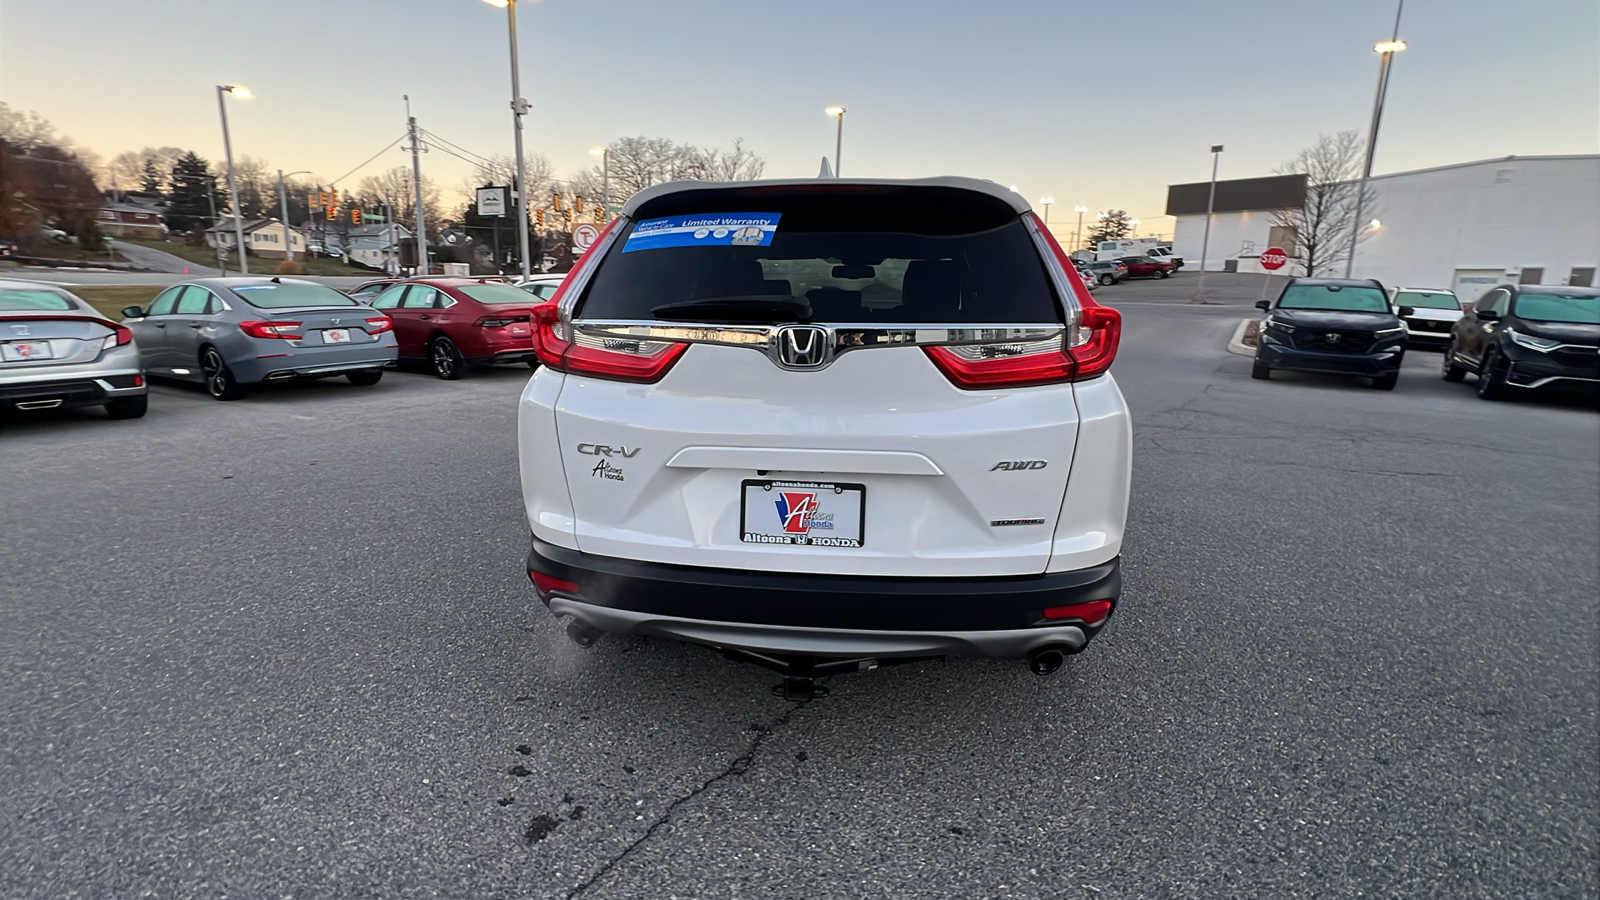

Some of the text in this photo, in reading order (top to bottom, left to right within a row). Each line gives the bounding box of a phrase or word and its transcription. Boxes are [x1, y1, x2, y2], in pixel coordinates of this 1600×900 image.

[681, 218, 771, 227] Limited Warranty
[1261, 253, 1287, 264] STOP
[577, 443, 642, 458] CR-V
[988, 460, 1048, 472] AWD
[604, 472, 624, 481] Honda
[771, 481, 835, 489] altoonahonda.com
[803, 520, 833, 529] Honda
[996, 518, 1043, 526] TOURING
[743, 533, 792, 544] Altoona
[811, 537, 860, 548] HONDA
